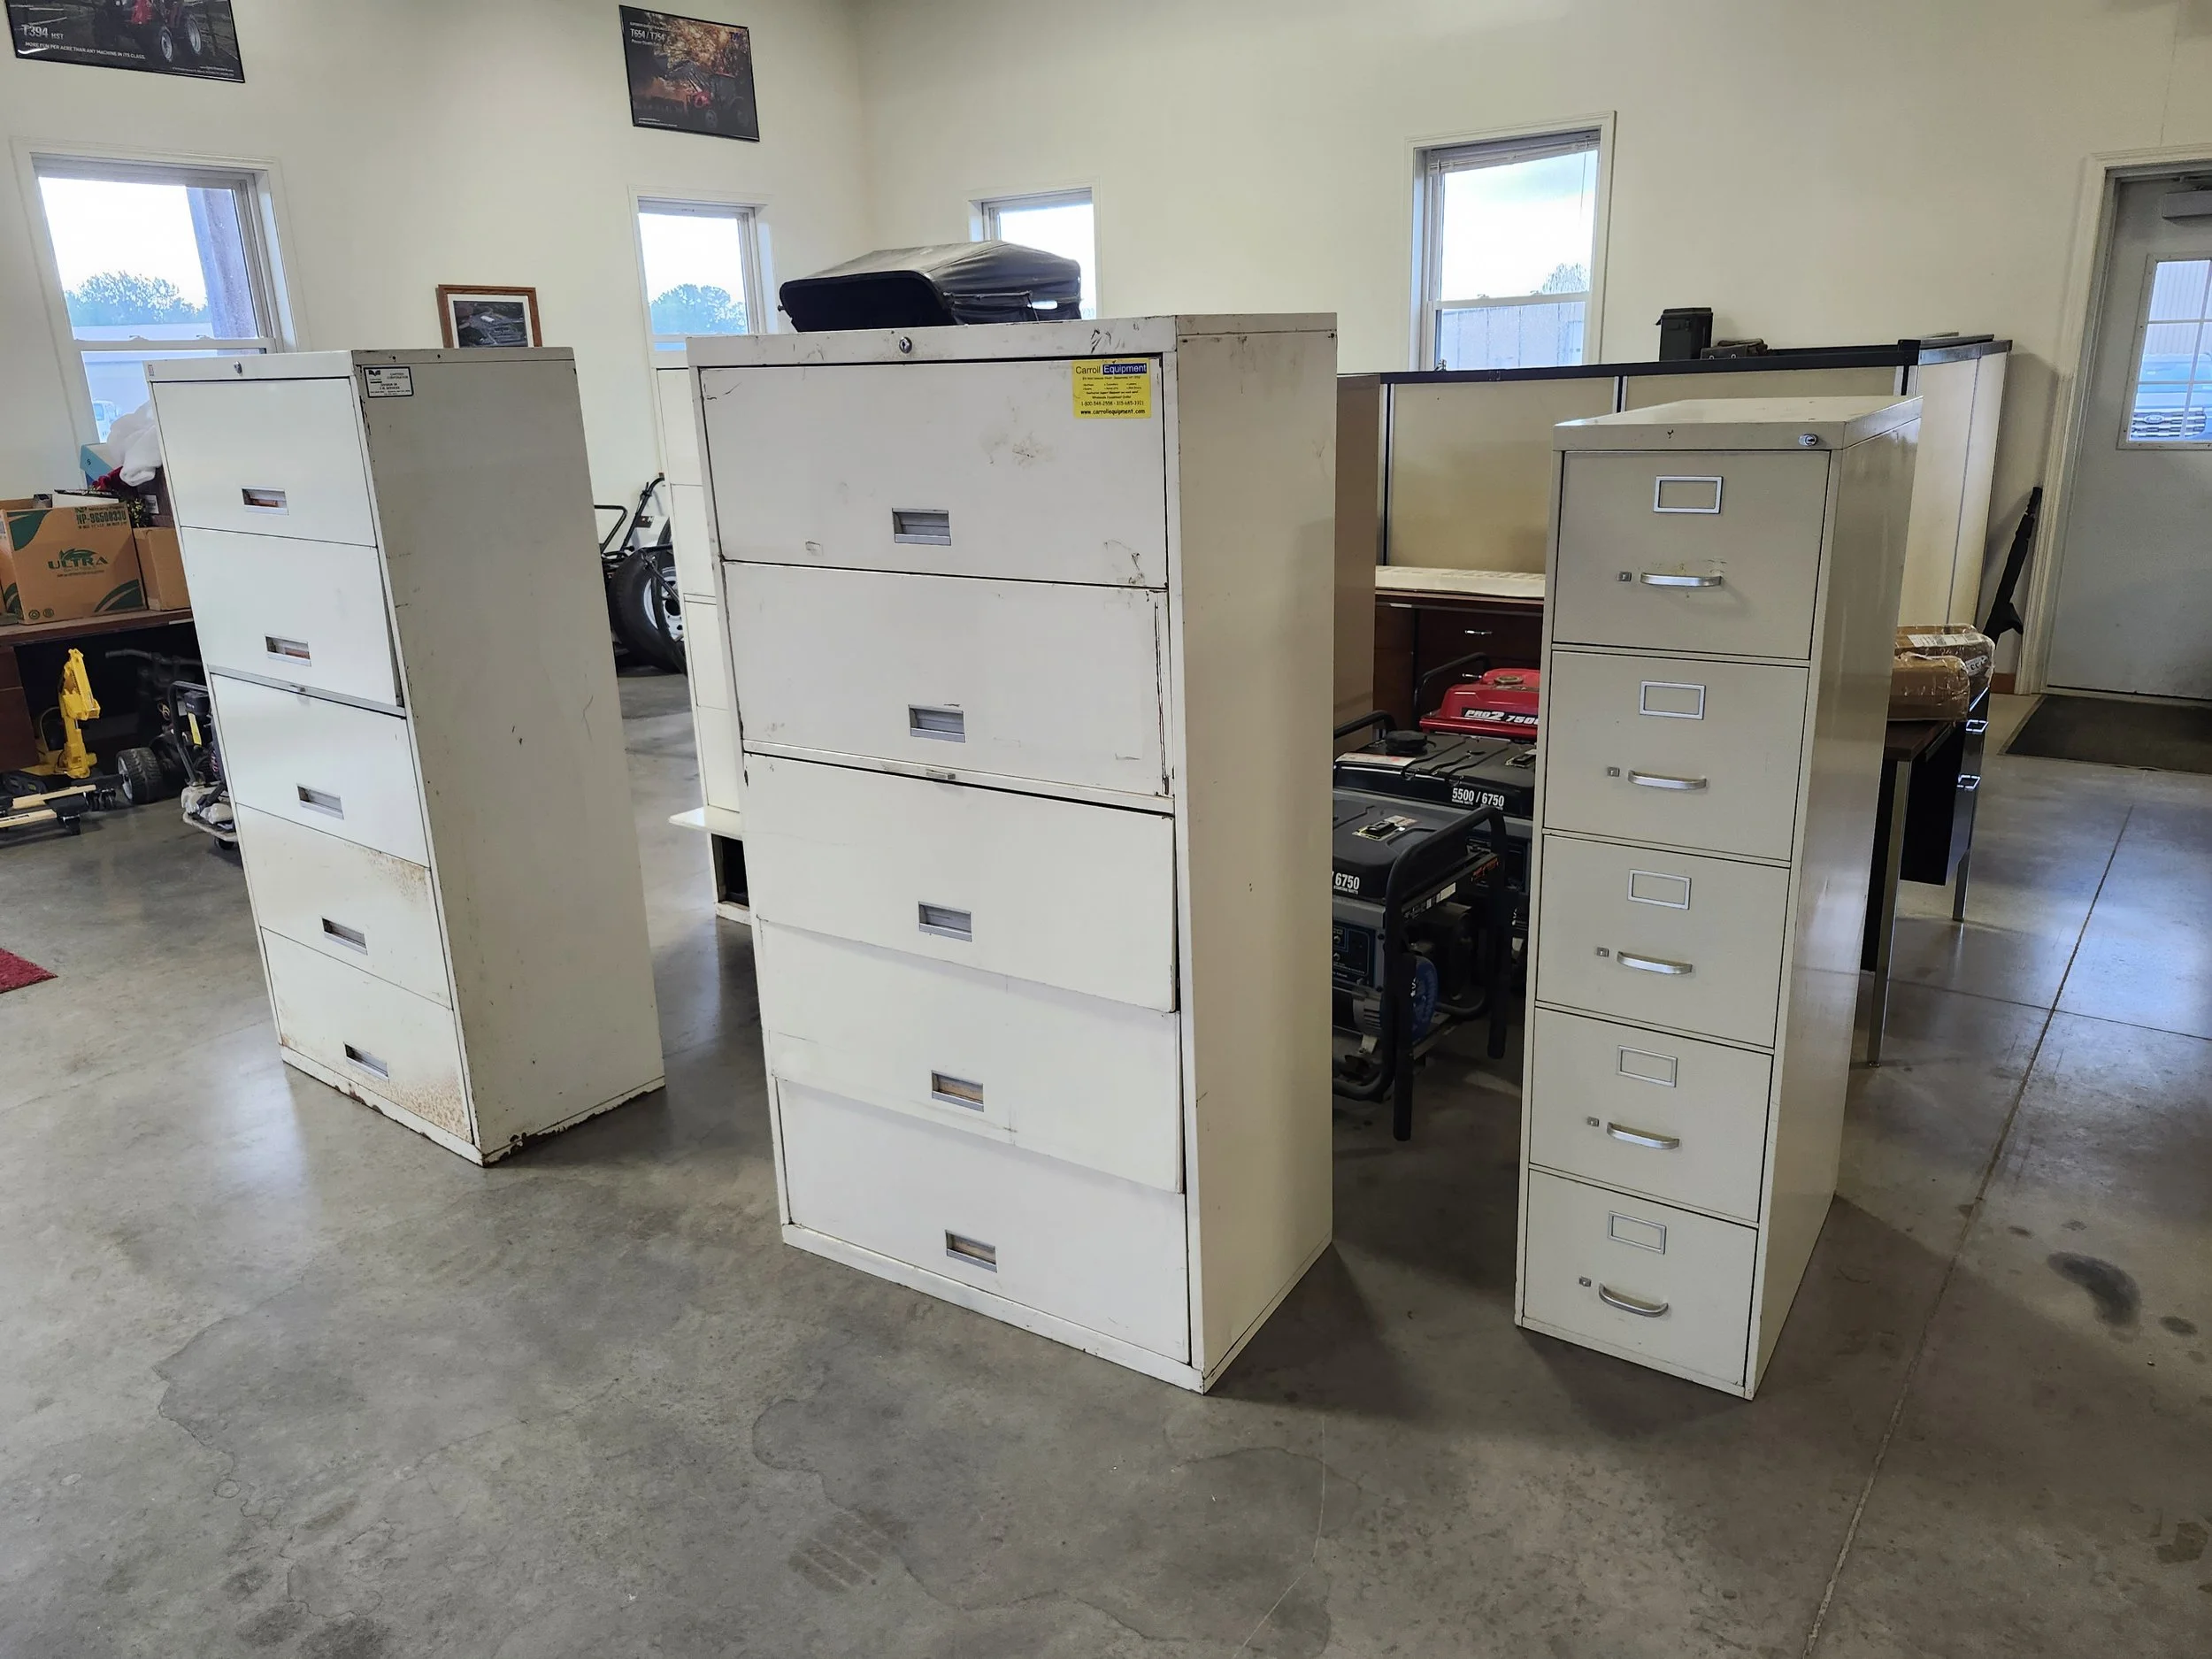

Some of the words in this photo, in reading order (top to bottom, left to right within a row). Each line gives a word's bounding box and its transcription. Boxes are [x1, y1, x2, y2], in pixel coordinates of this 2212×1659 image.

[21, 24, 49, 38] T394
[1075, 365, 1101, 374] Carroll
[1103, 363, 1147, 375] Equipment
[48, 557, 108, 569] ULTRA
[1464, 710, 1504, 720] PRO2
[1452, 787, 1475, 802] 5500
[1475, 791, 1481, 803] /
[1482, 792, 1504, 807] 6750
[1335, 872, 1360, 890] 6750
